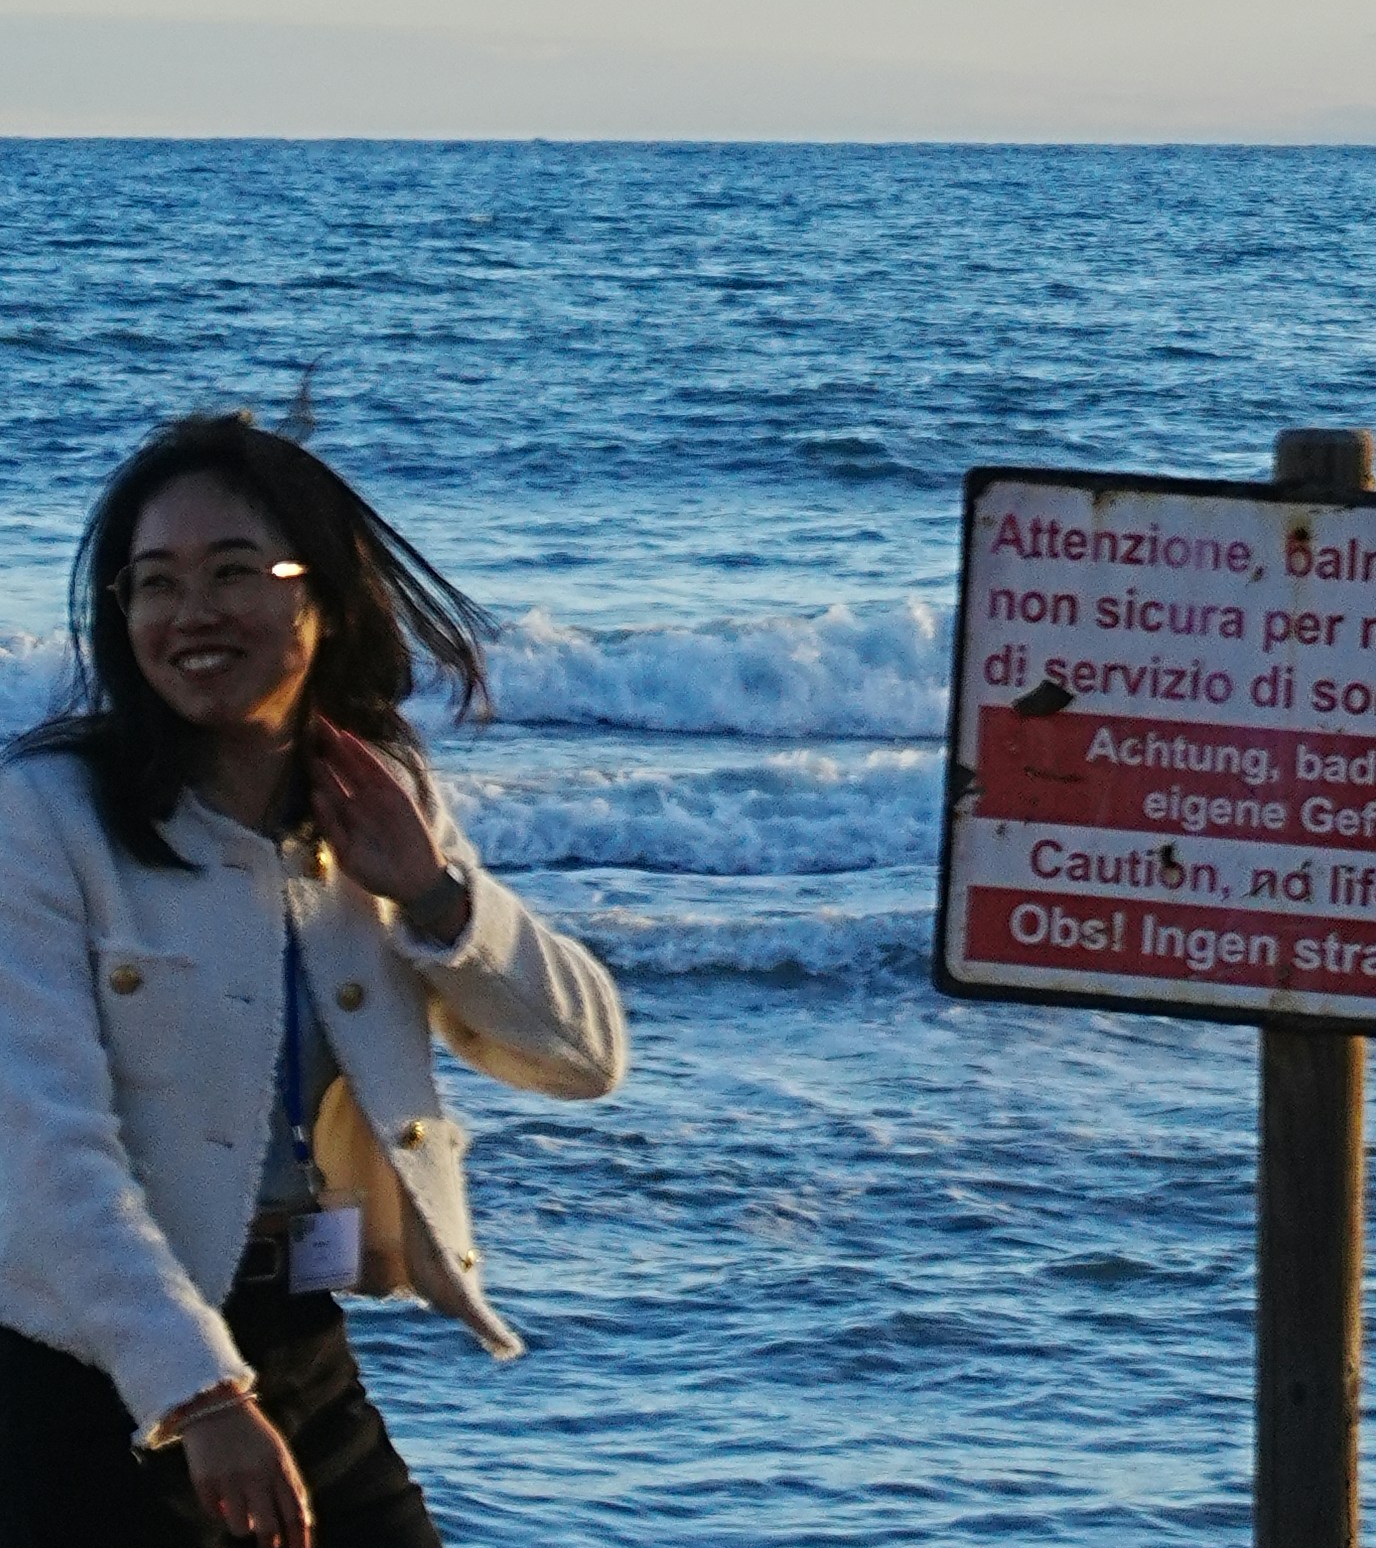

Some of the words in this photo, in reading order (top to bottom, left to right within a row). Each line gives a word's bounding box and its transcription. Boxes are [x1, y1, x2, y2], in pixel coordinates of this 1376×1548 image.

[993, 514, 1264, 581] Attenzione,
[988, 587, 1077, 626] non
[1096, 587, 1245, 639] sicura
[1263, 607, 1343, 652] per
[984, 645, 1026, 688] di
[1044, 655, 1233, 704] servizio
[1251, 667, 1293, 710] di
[1086, 726, 1279, 785] Achtung,
[1144, 786, 1286, 834] eigene
[1031, 840, 1231, 898] Caution,
[1250, 864, 1310, 902] no
[1010, 904, 1124, 951] Obs!
[1141, 916, 1277, 970] Ingen
